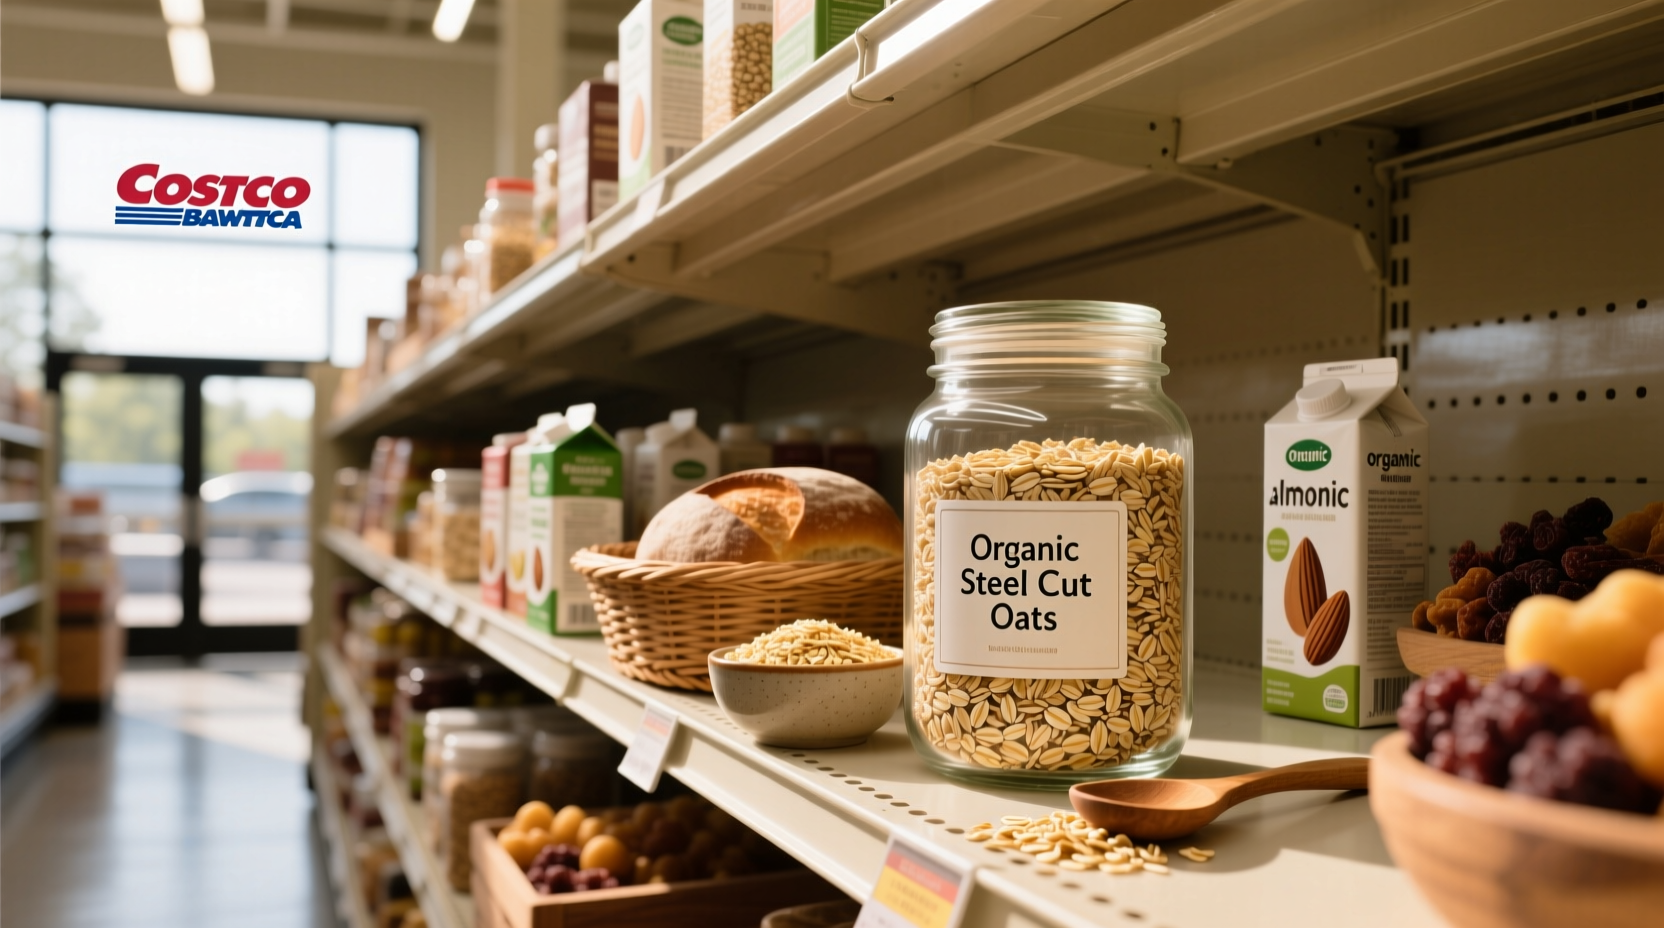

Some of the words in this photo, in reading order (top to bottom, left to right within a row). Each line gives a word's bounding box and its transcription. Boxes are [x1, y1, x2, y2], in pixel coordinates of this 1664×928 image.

[117, 163, 311, 208] COSTCO
[970, 533, 1079, 568] Organic
[960, 568, 1028, 596] Steel
[1038, 569, 1092, 597] Cut
[990, 602, 1058, 631] Oats
